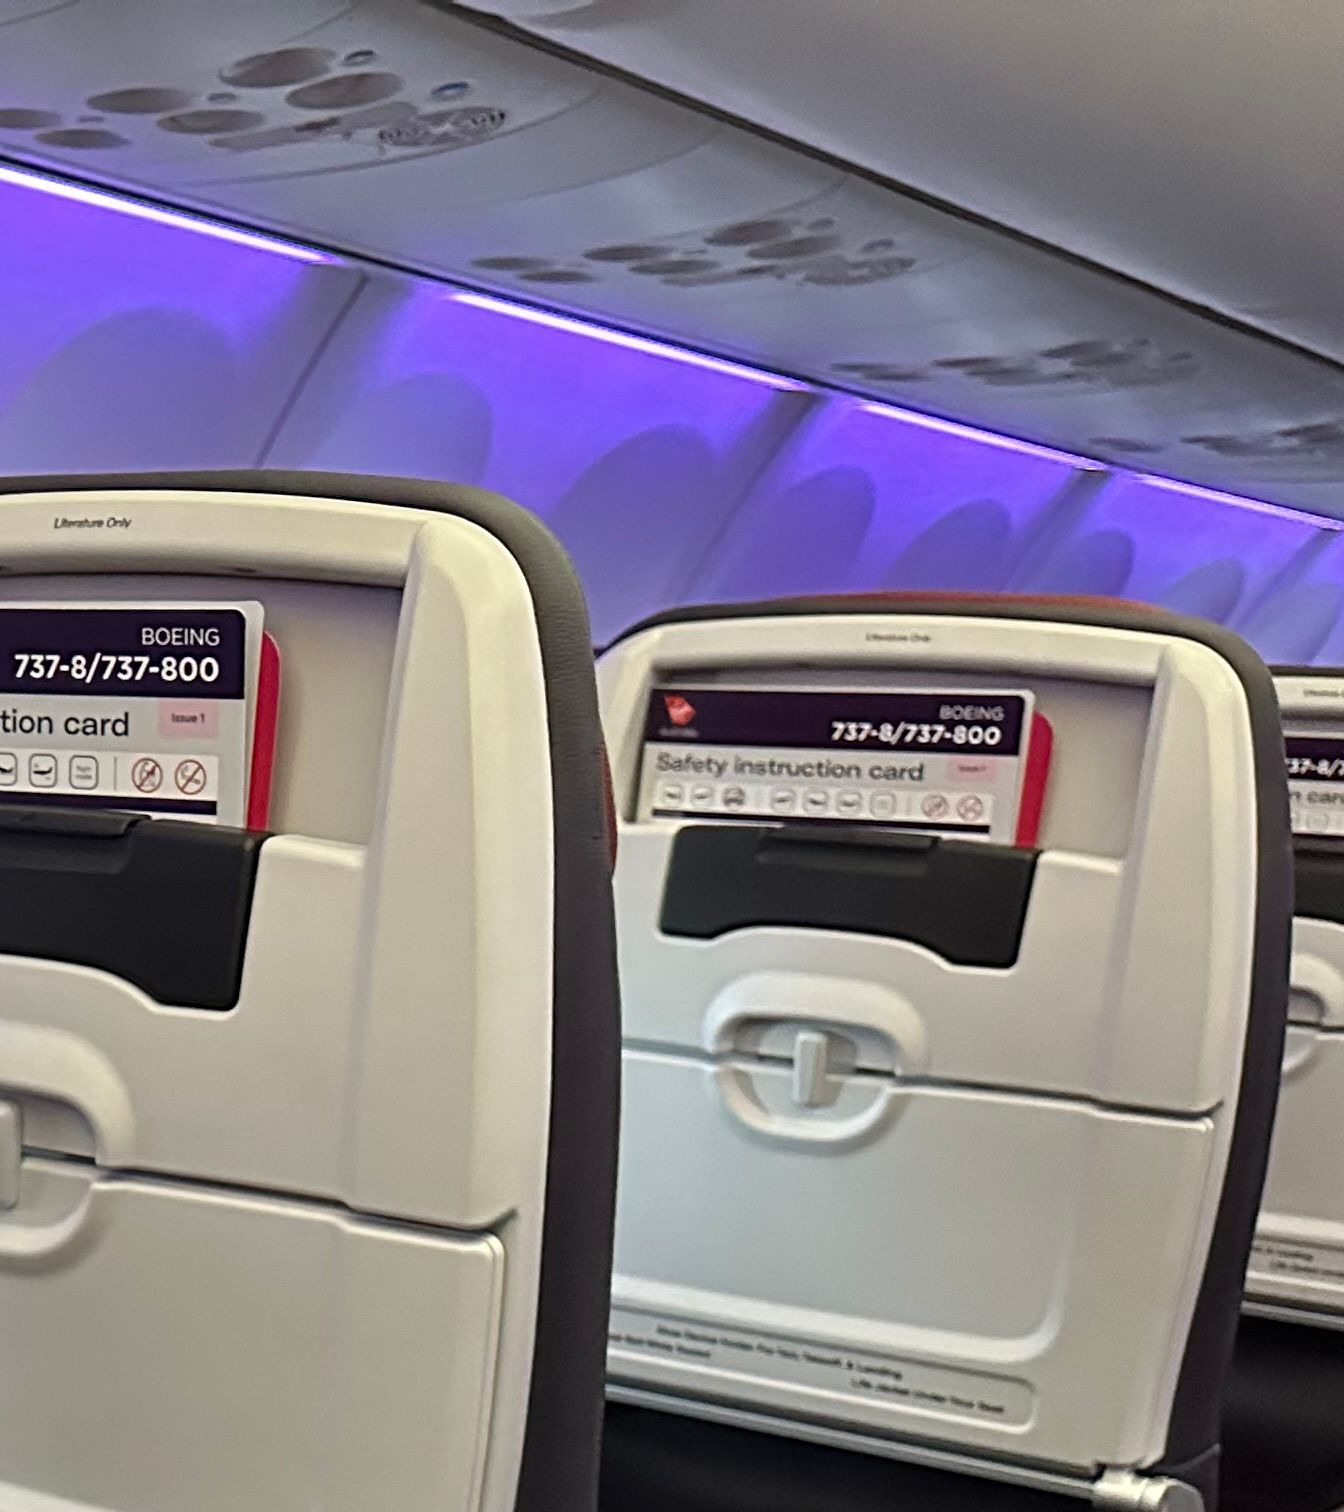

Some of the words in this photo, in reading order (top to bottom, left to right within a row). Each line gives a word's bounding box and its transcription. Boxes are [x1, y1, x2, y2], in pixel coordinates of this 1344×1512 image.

[53, 517, 105, 530] Literature
[107, 516, 133, 530] Only
[141, 627, 221, 647] BOEING
[14, 653, 220, 684] 737-8/737-800
[63, 711, 130, 737] card
[170, 713, 197, 723] Issue
[939, 704, 1005, 722] BOEING
[831, 720, 1002, 747] 737-8/737-800
[656, 751, 729, 778] Safety
[733, 753, 862, 781] instruction
[868, 762, 925, 782] card
